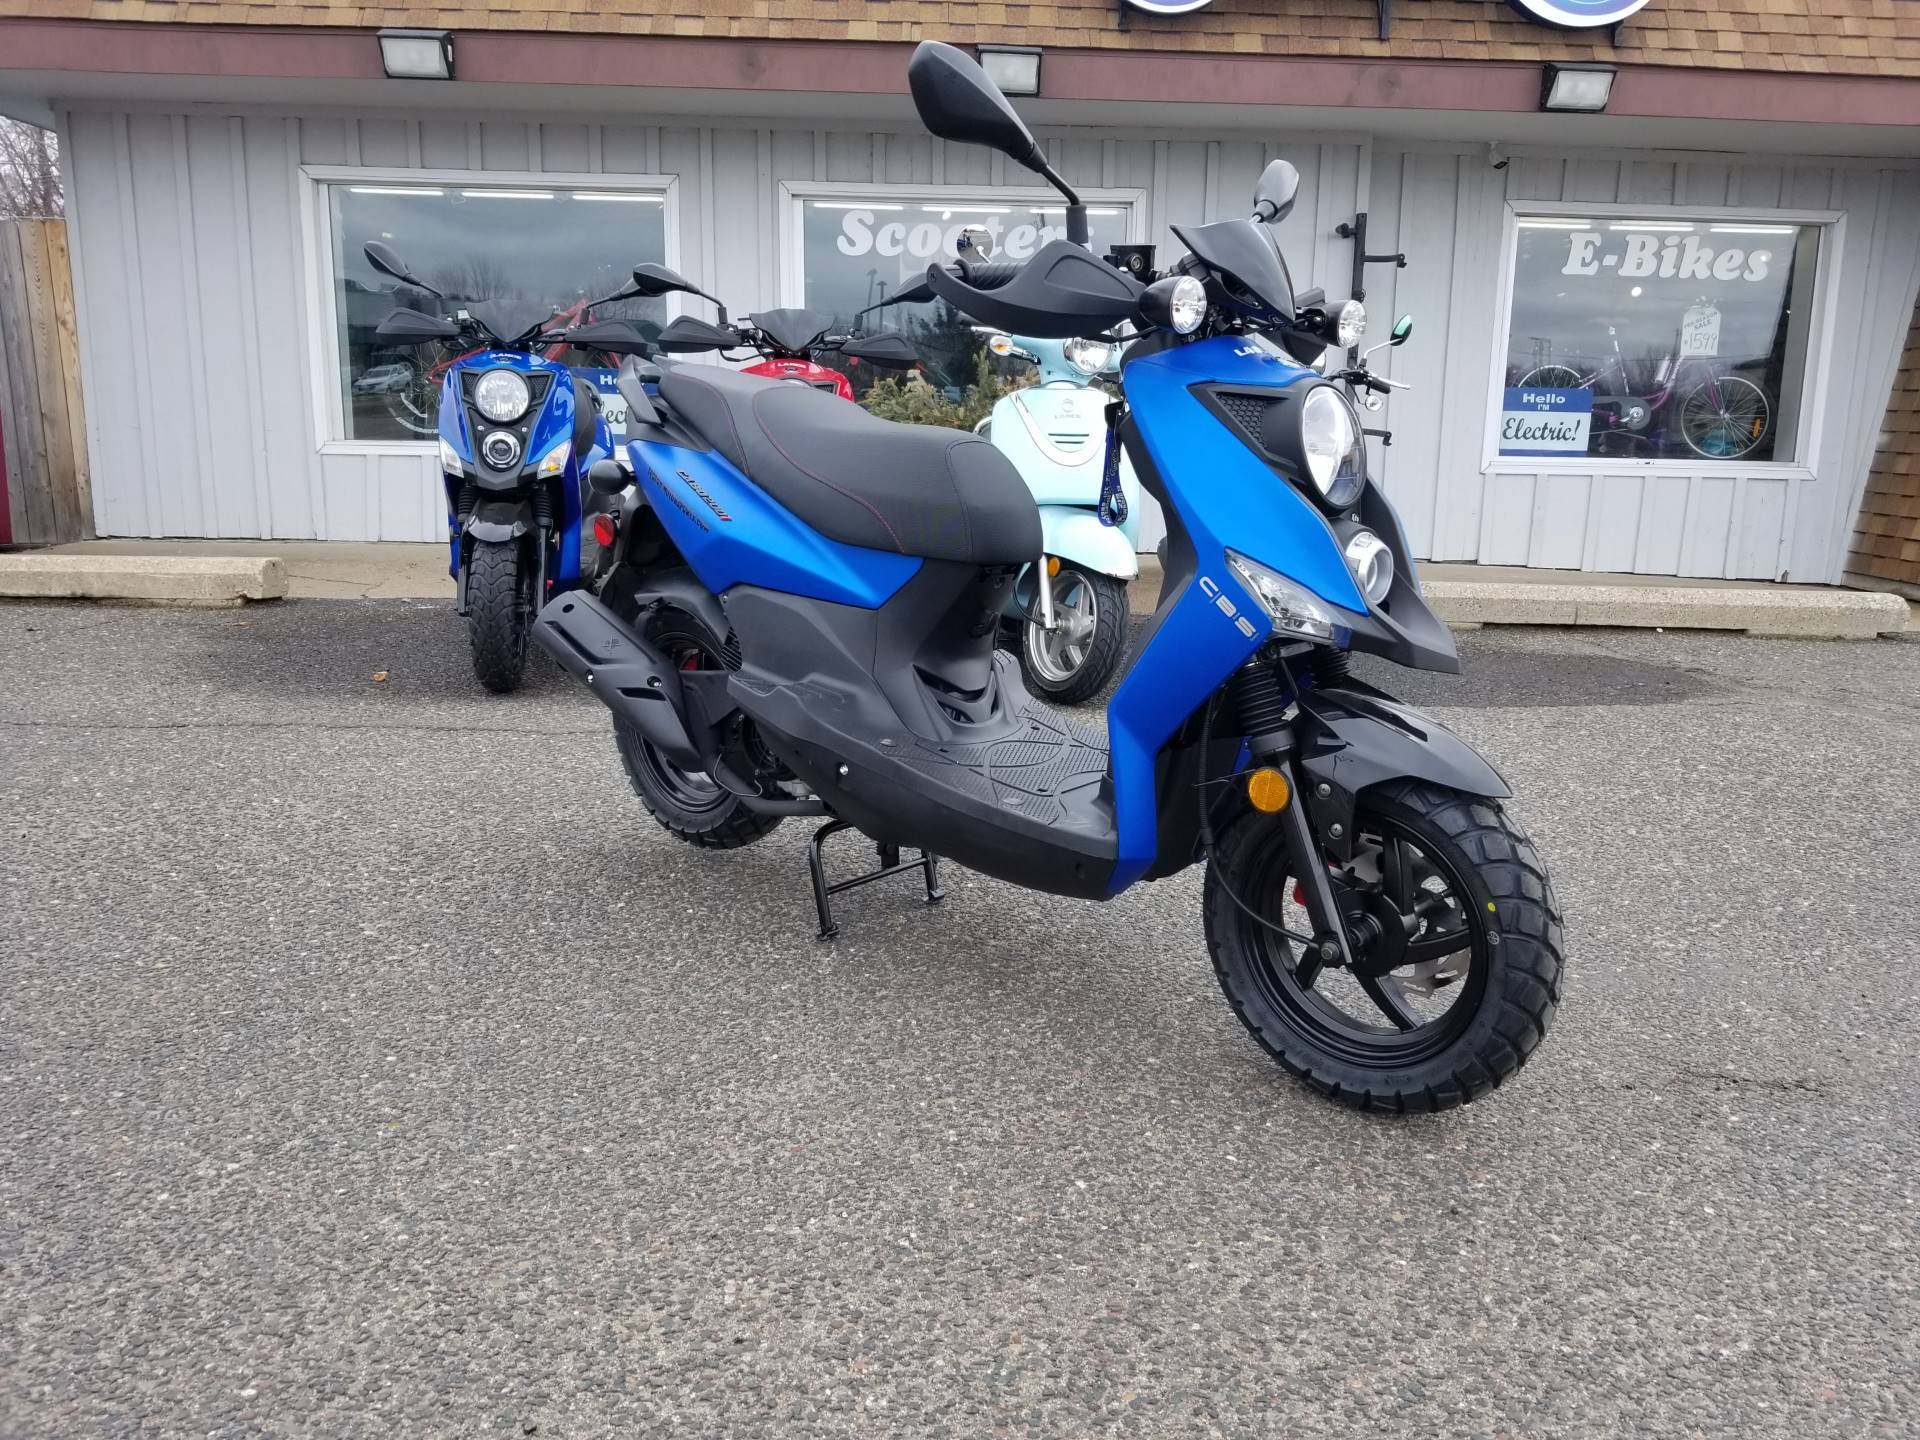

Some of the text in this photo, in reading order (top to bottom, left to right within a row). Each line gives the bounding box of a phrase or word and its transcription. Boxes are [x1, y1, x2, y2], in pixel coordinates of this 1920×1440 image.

[837, 209, 1094, 259] Scoter
[1561, 232, 1772, 282] E-Bikes
[1522, 393, 1566, 404] Hello
[1502, 417, 1581, 441] Electric!
[1199, 576, 1257, 638] CBS
